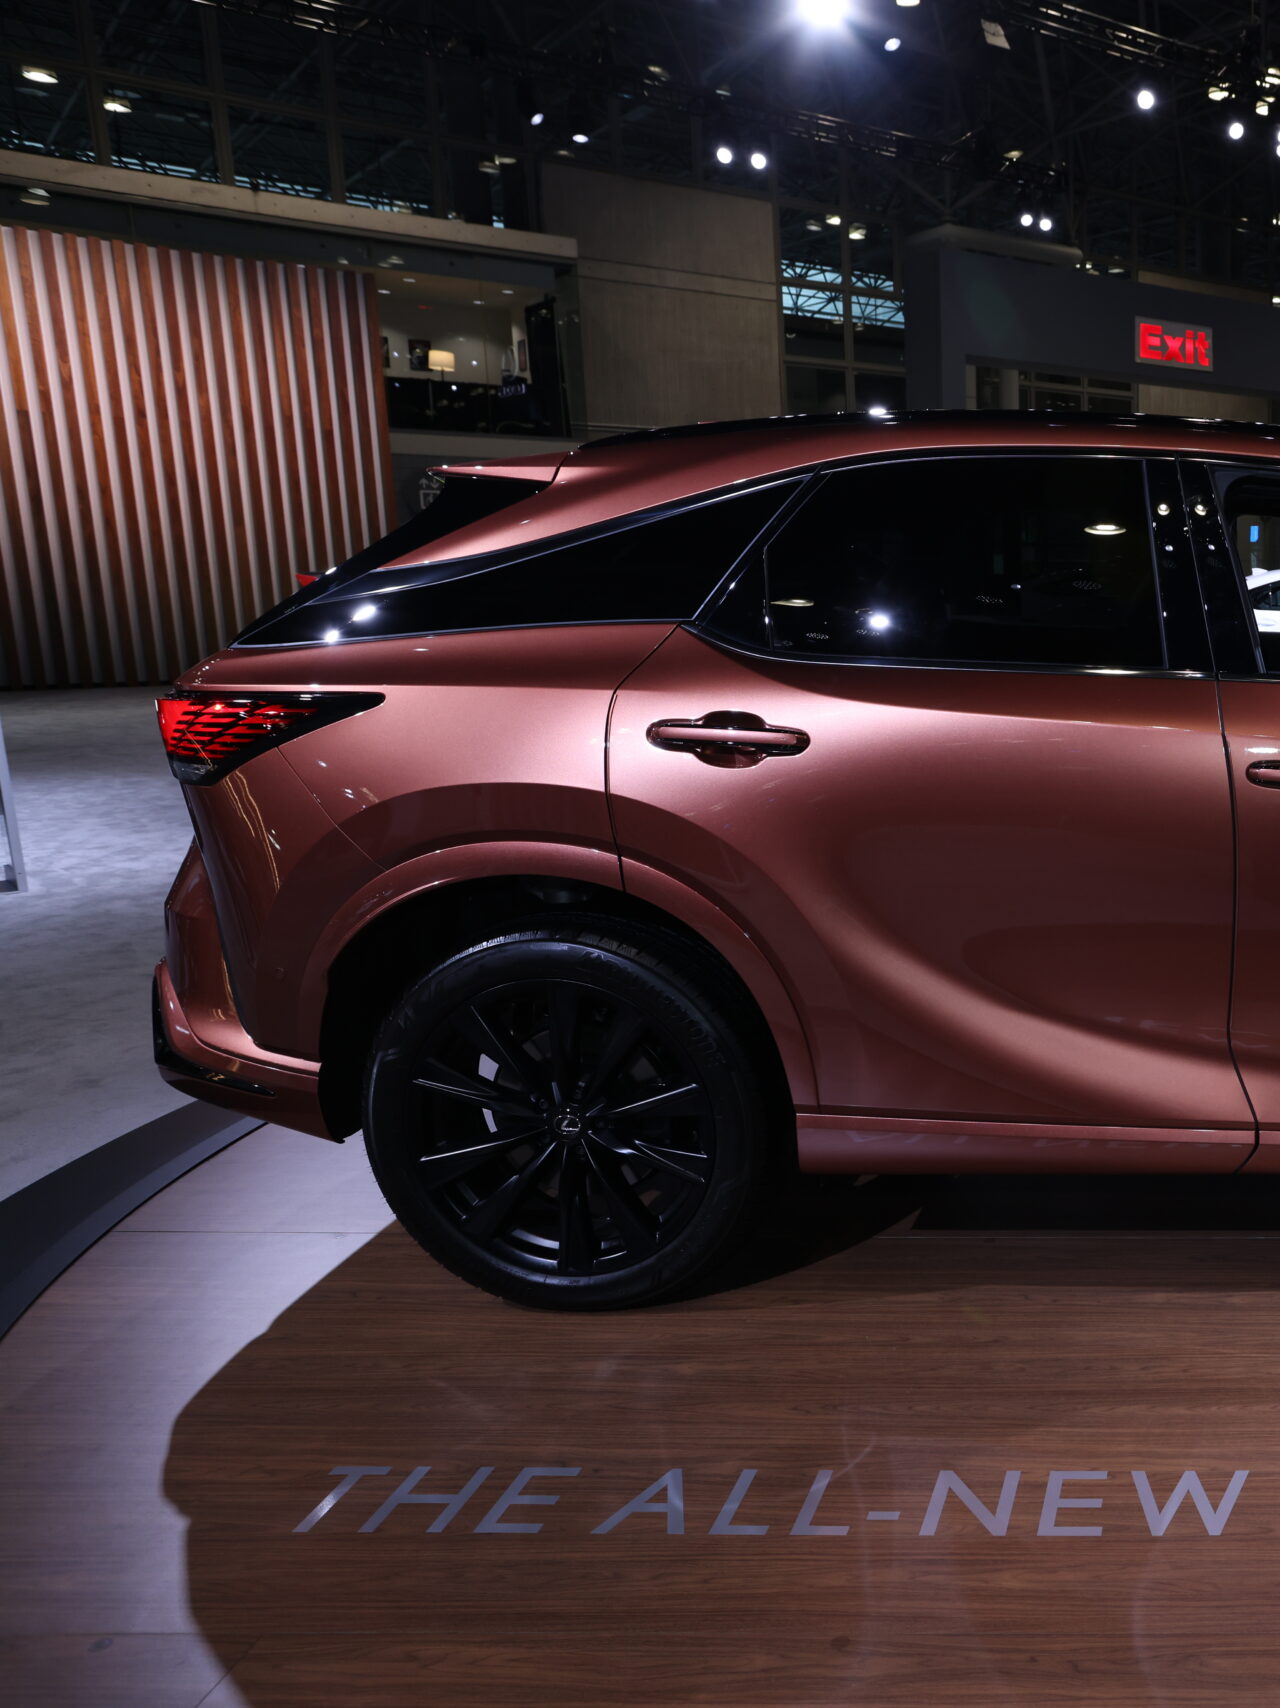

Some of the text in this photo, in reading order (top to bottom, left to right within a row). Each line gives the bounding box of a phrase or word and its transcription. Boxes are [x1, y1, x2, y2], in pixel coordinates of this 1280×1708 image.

[1139, 323, 1210, 366] Exit
[292, 1466, 582, 1533] THE
[590, 1468, 1250, 1536] ALL-NEW
